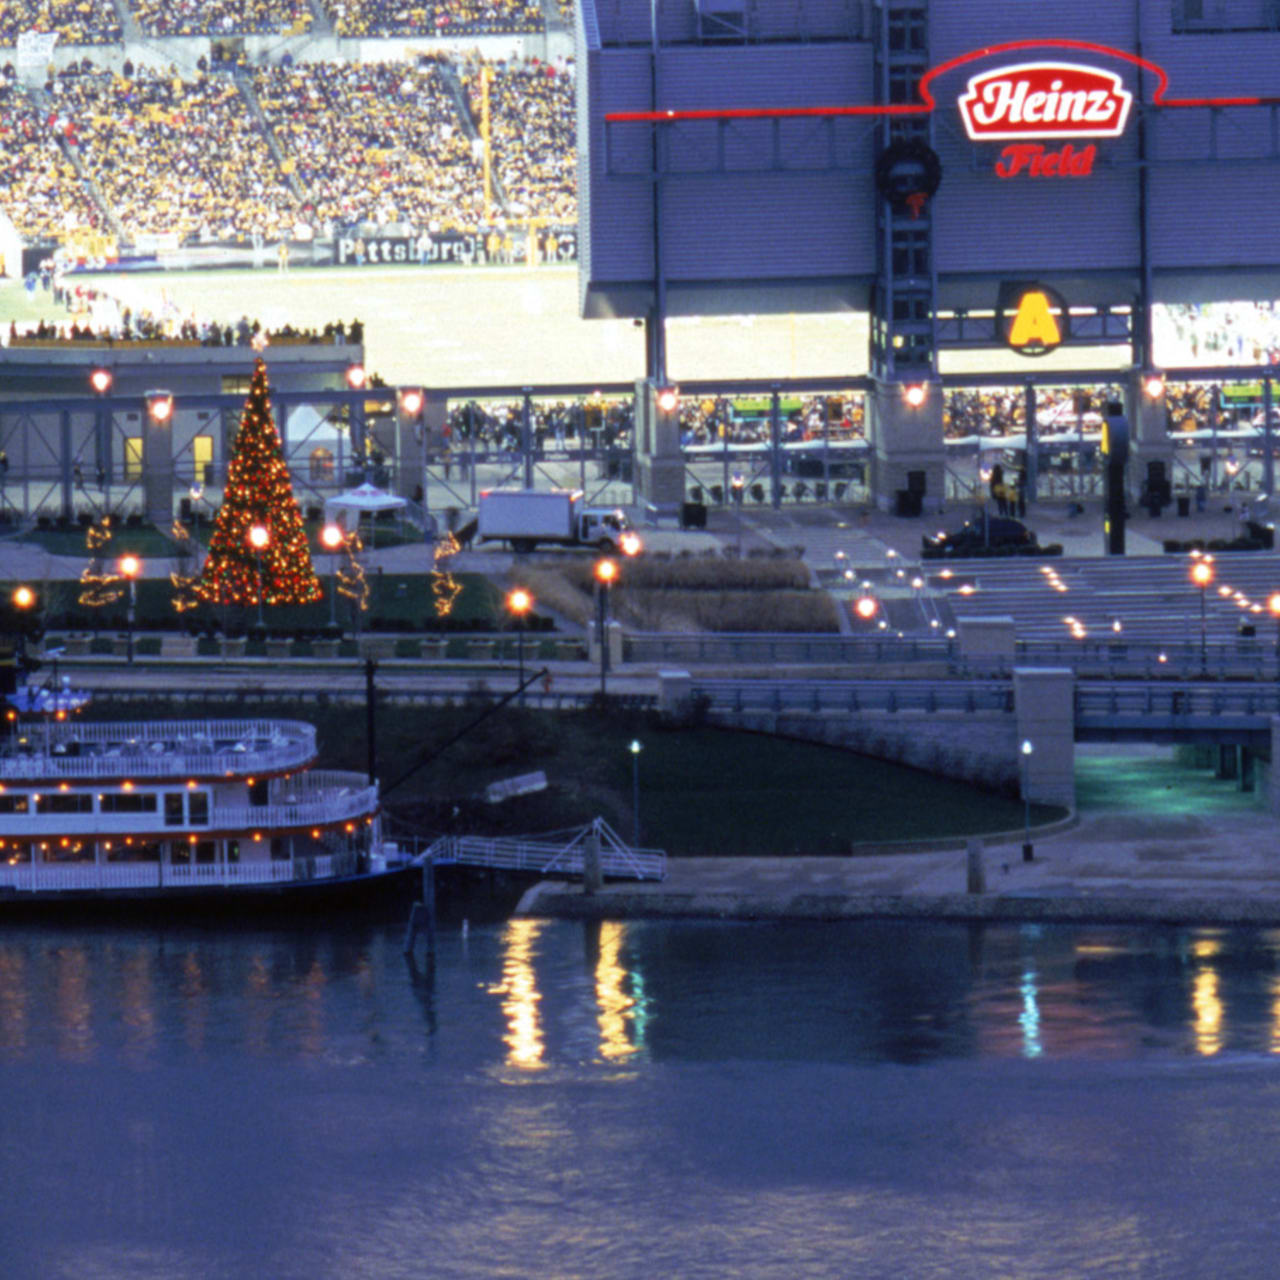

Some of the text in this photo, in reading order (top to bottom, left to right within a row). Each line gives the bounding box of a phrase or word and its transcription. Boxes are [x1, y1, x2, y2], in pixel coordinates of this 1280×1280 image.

[972, 79, 1117, 125] Heinz
[994, 143, 1097, 178] Field
[1008, 291, 1061, 345] A
